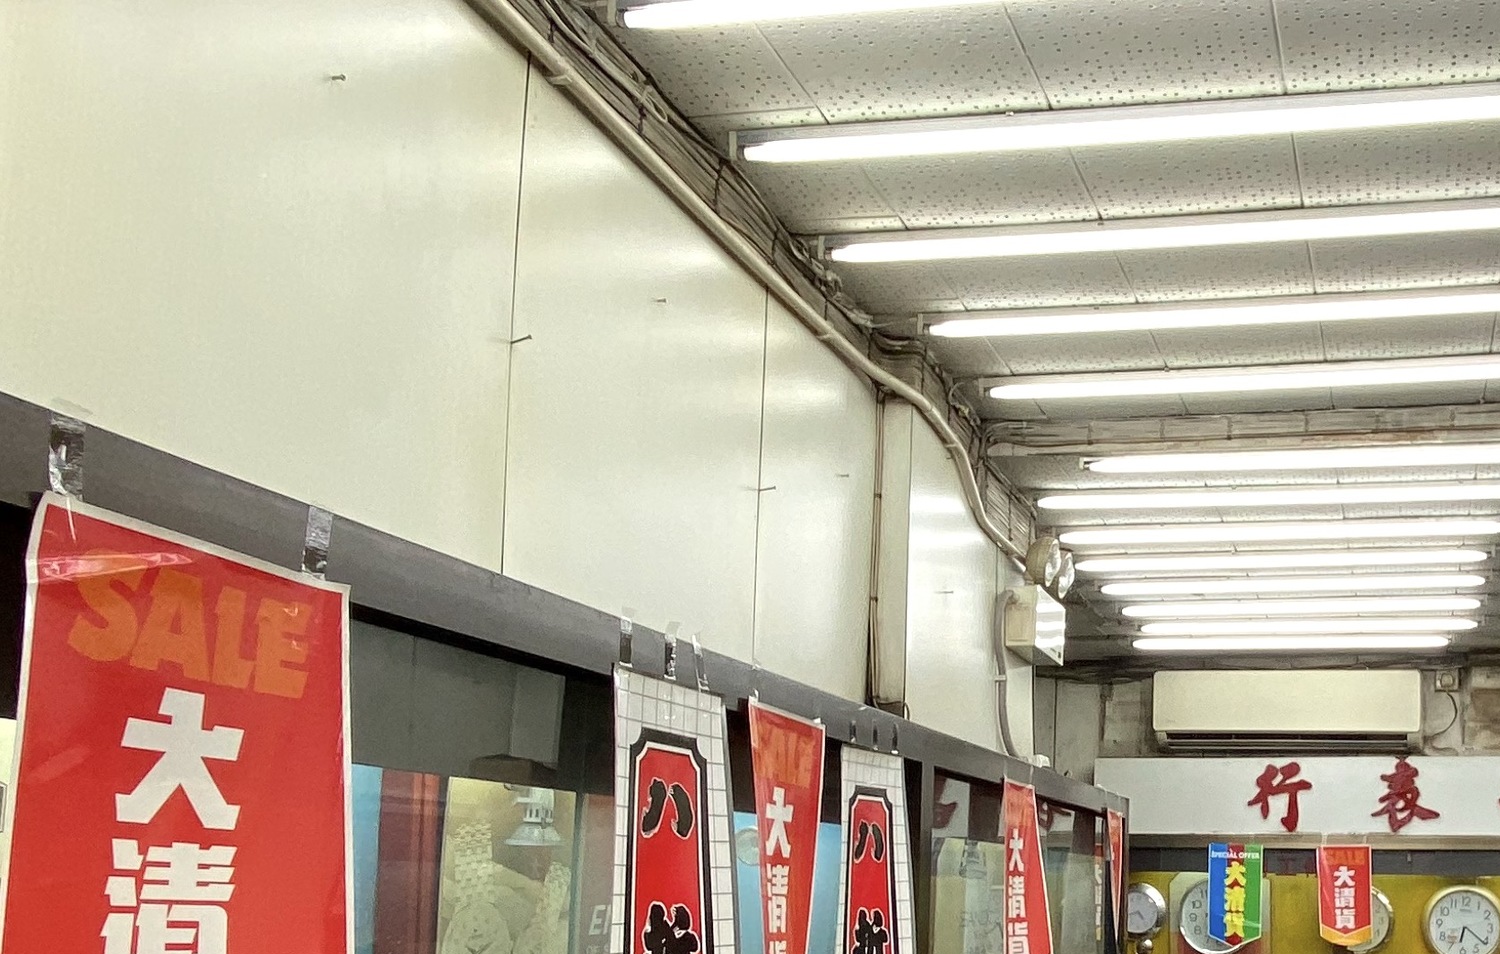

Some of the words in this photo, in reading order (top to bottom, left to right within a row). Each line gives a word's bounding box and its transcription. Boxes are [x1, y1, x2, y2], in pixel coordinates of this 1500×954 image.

[68, 548, 313, 700] SALE
[1334, 866, 1356, 929] 大清貨
